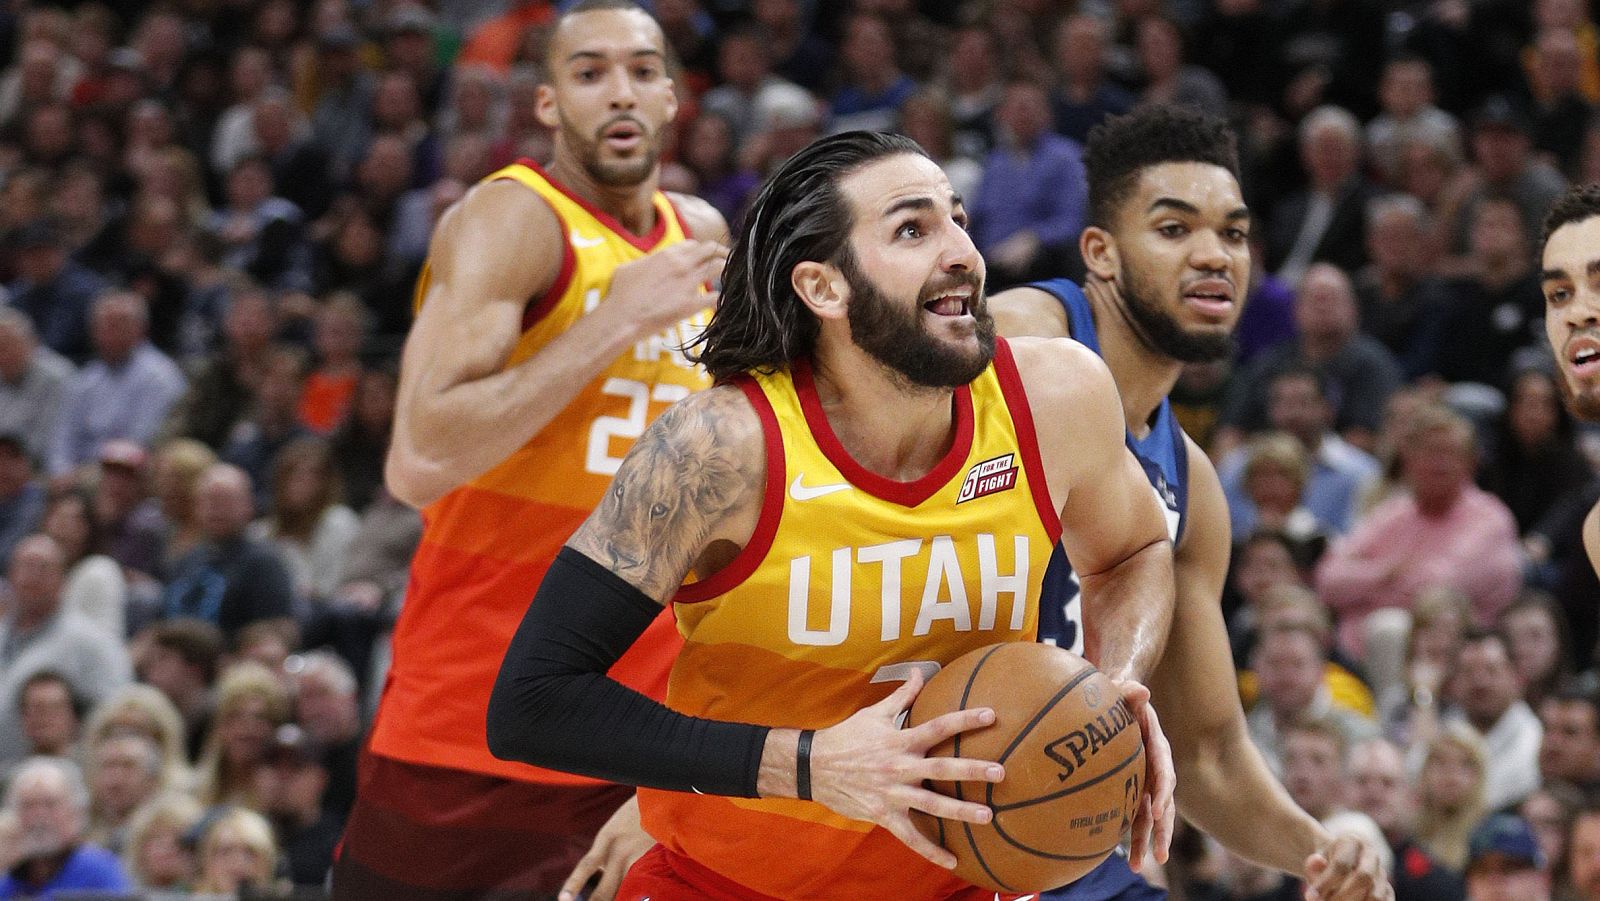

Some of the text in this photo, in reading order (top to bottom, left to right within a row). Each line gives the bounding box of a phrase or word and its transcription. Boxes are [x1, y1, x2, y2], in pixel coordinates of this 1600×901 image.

[586, 377, 691, 476] 2
[983, 459, 1009, 473] FOR THE
[962, 469, 977, 498] 5
[978, 472, 1013, 494] FIGHT
[788, 533, 1030, 646] UTAH
